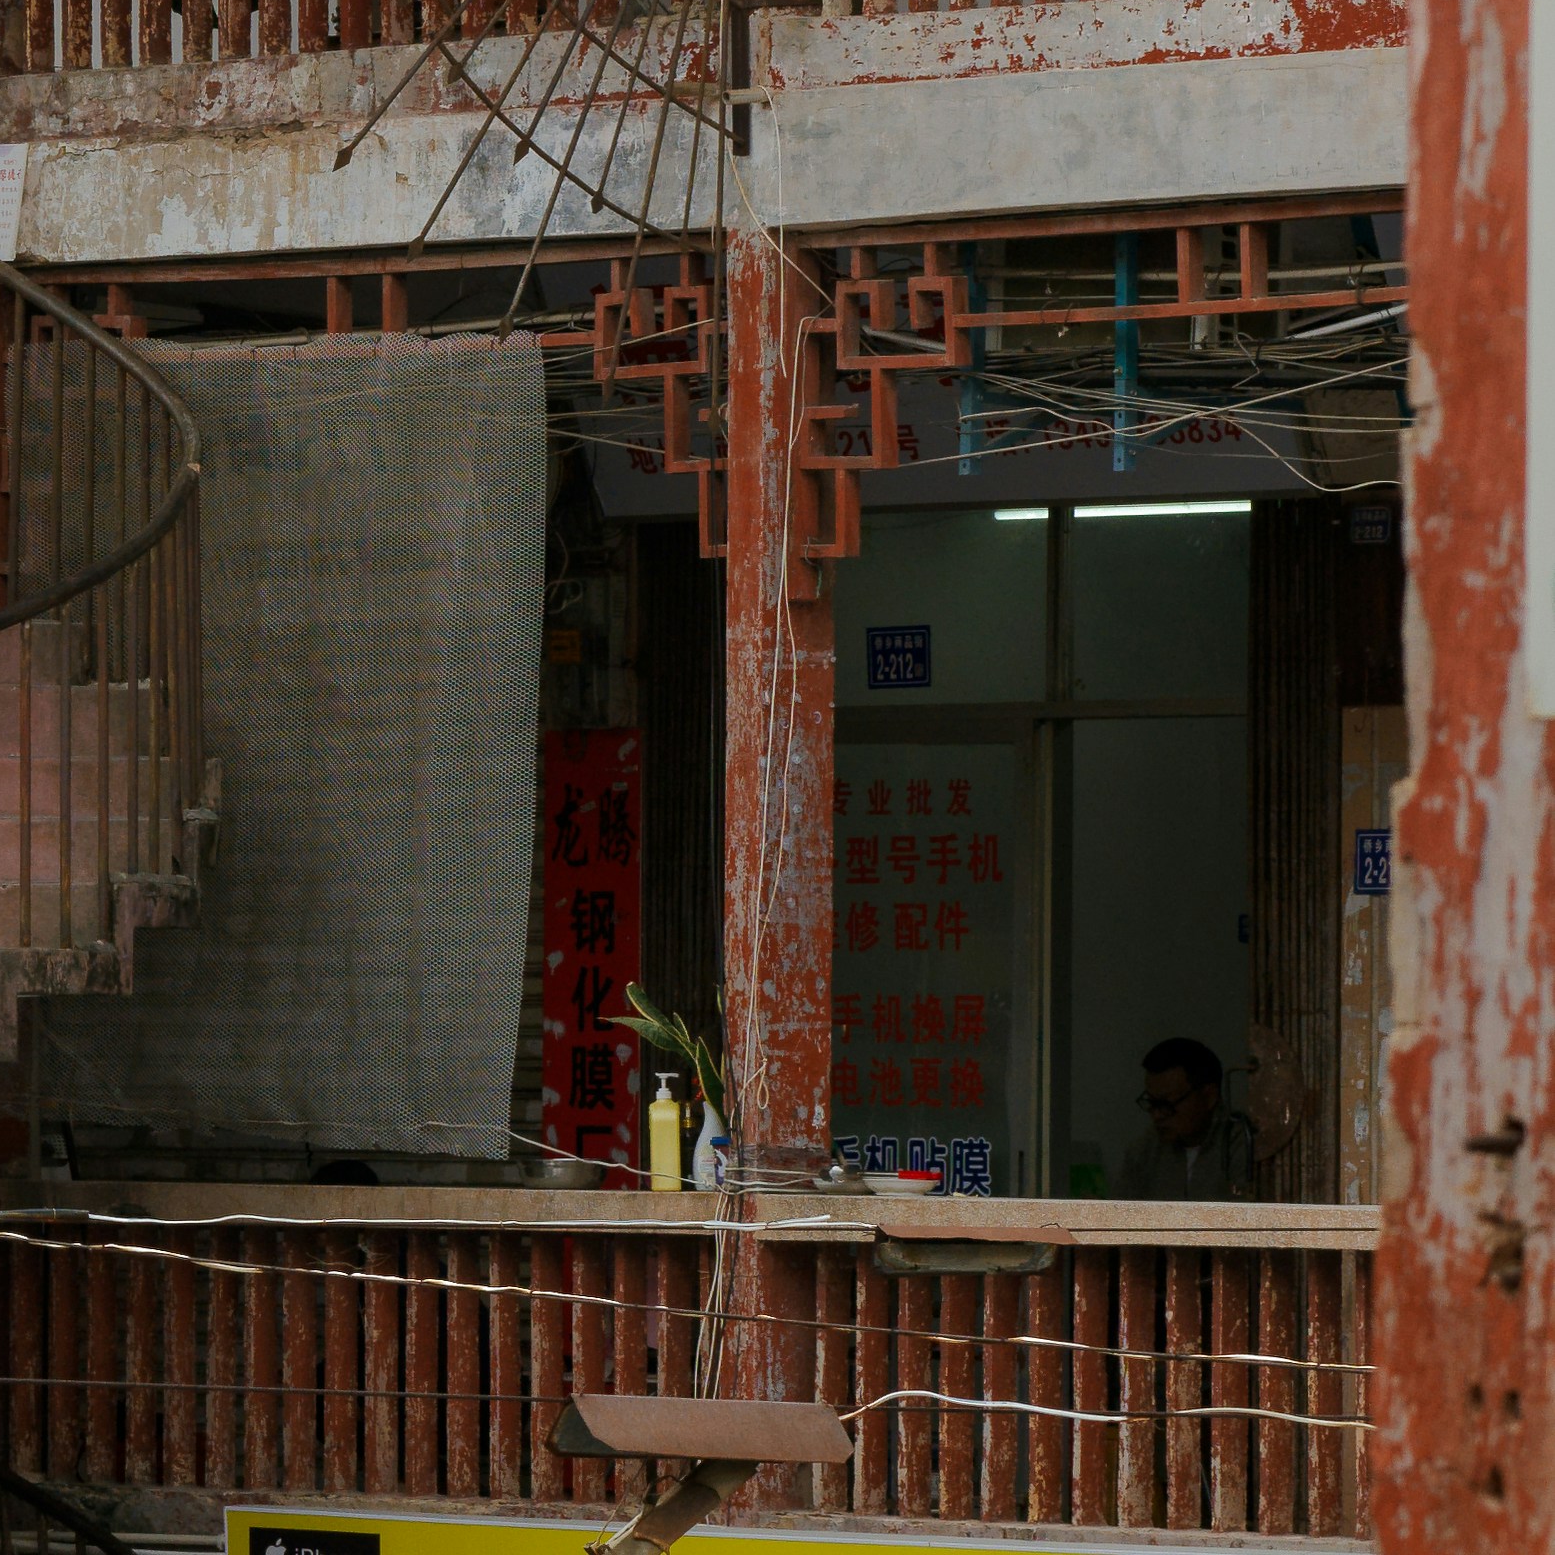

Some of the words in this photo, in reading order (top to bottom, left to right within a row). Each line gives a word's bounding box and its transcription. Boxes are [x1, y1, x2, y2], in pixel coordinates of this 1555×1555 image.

[833, 777, 972, 816] 专业批发
[833, 833, 1003, 886] 型号手机
[569, 888, 616, 1162] 钢化膜厂
[832, 992, 988, 1046] 手机换屏
[832, 1055, 985, 1109] 电池更换
